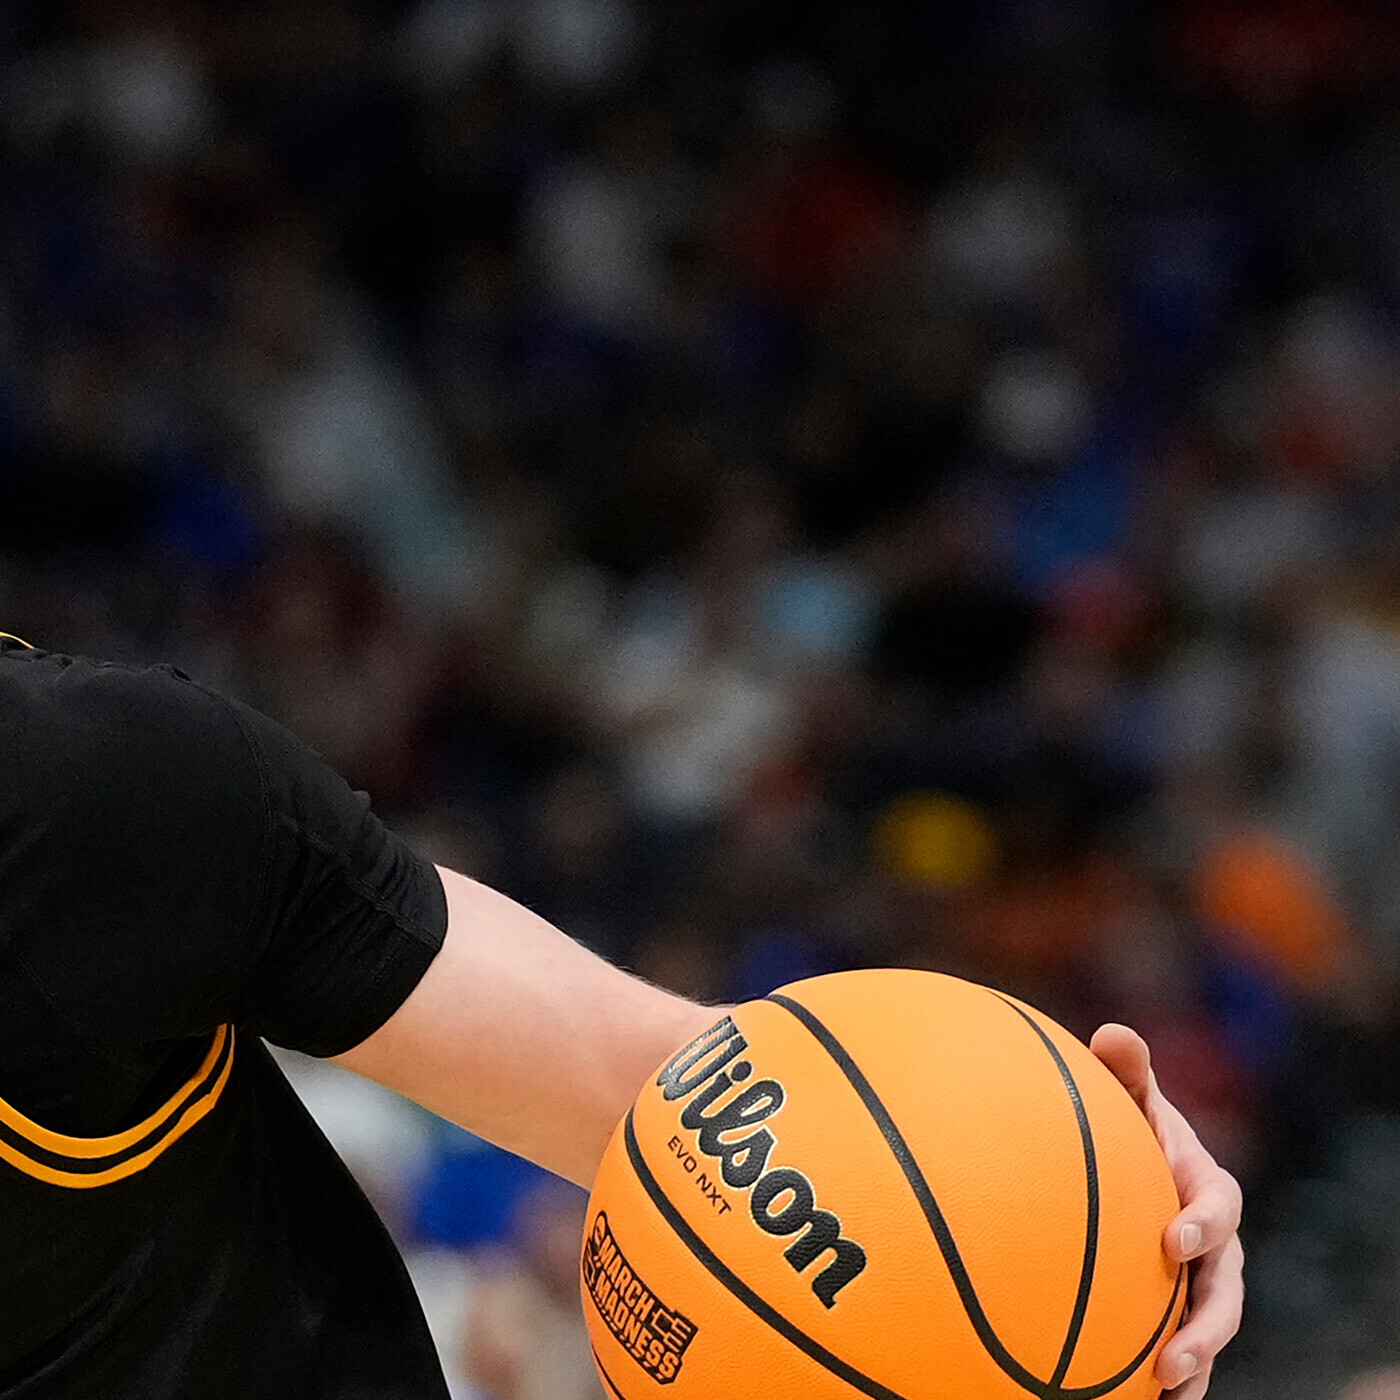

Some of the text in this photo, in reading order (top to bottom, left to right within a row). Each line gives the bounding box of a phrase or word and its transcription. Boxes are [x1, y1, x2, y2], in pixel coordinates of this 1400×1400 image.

[656, 1015, 867, 1310] Wilson
[667, 1135, 732, 1216] EVO NXT
[594, 1270, 680, 1379] MADNESS
[597, 1234, 656, 1322] MARCH
